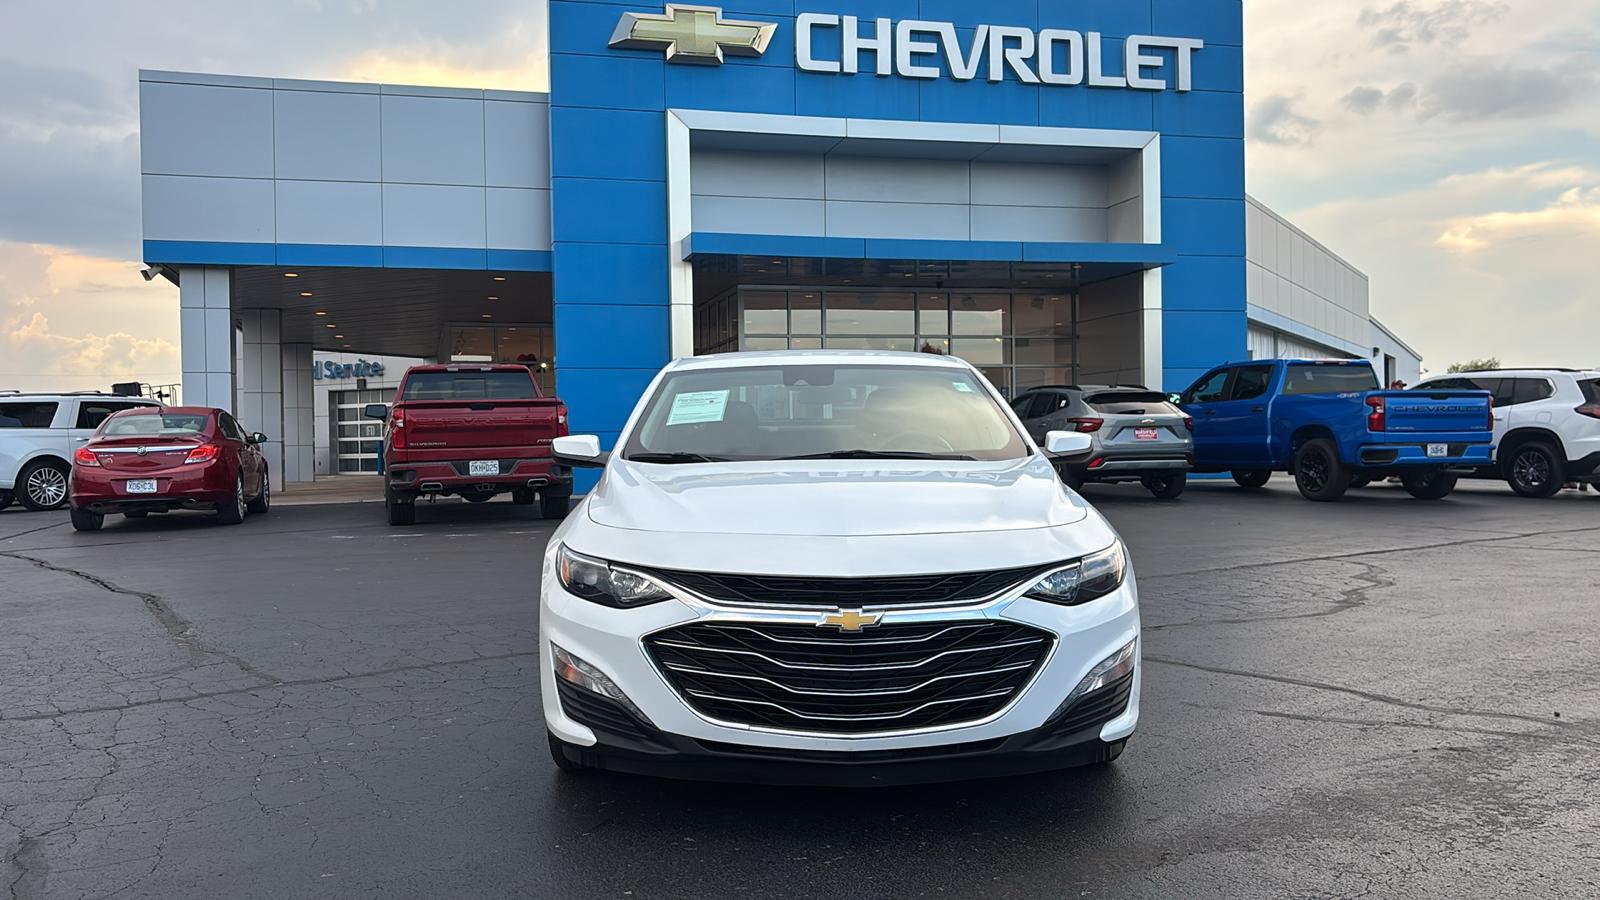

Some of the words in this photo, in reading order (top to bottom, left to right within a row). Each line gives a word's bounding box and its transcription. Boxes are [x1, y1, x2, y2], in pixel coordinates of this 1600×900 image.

[795, 12, 1205, 93] CHEVROLET
[324, 358, 383, 379] Service
[1394, 405, 1482, 413] CHEVROLET
